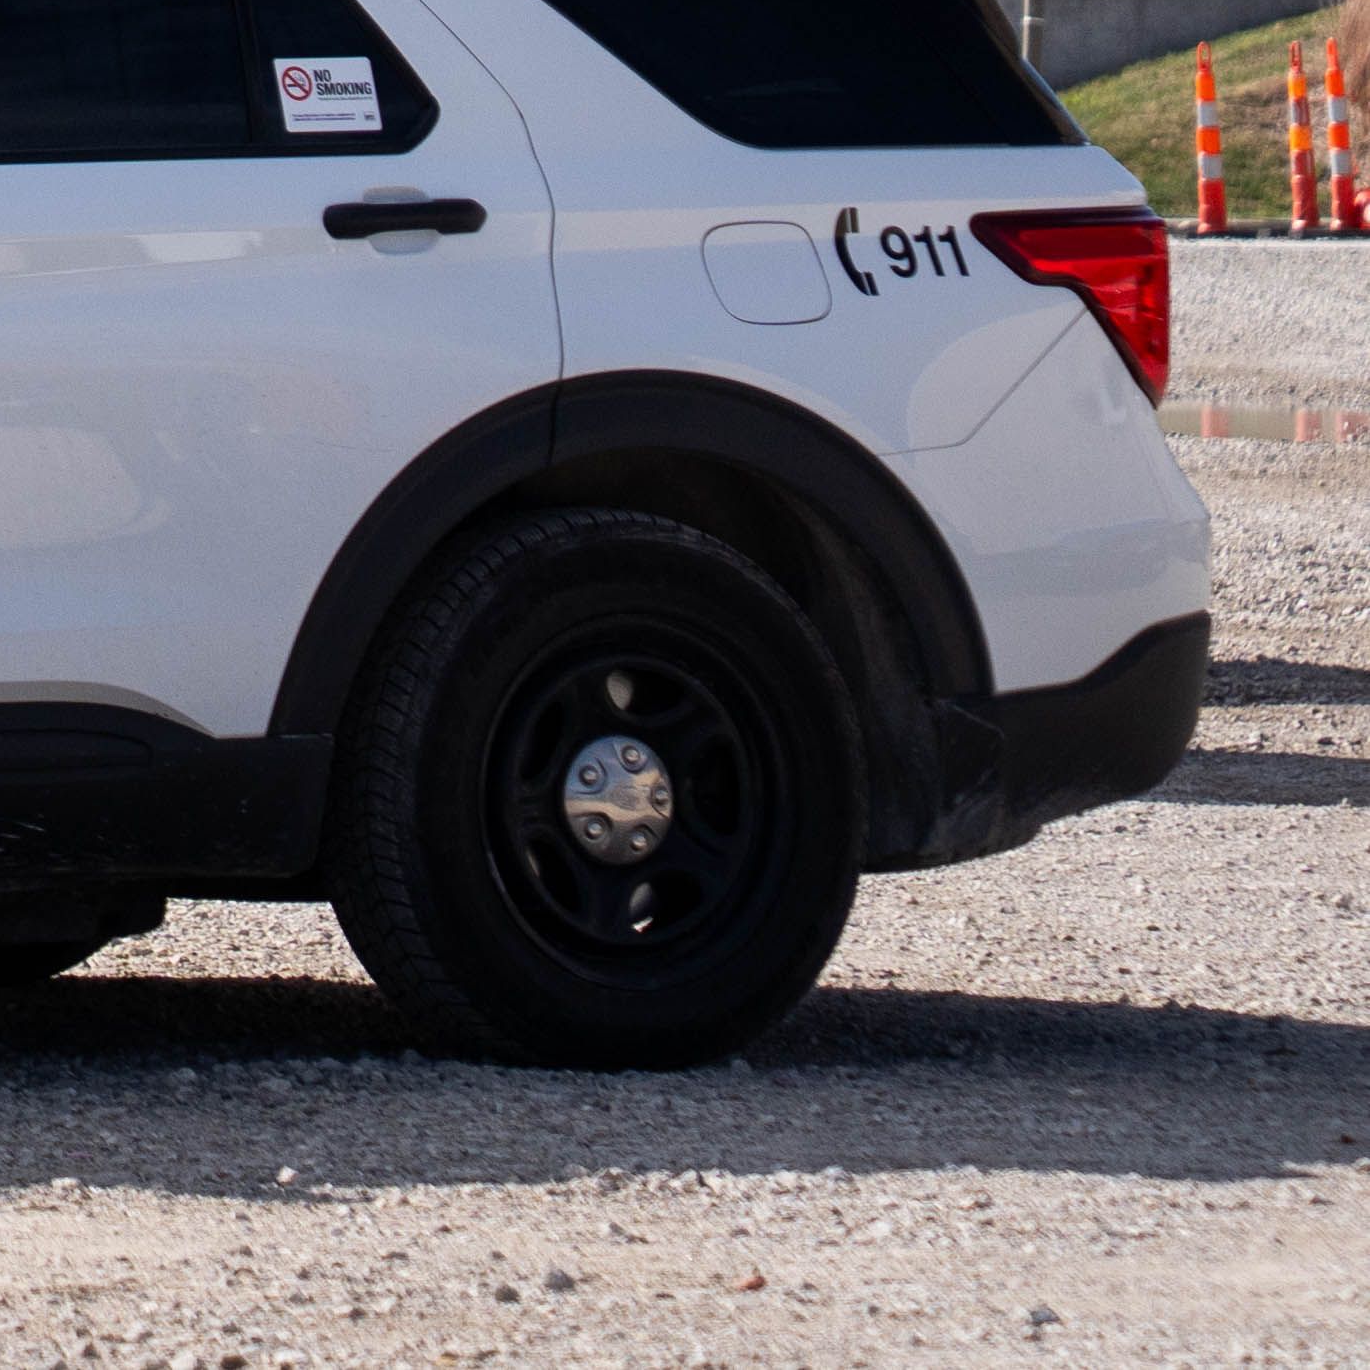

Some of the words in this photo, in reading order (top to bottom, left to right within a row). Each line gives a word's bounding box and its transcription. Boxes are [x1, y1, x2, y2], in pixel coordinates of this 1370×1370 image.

[313, 69, 332, 82] NO
[316, 81, 373, 96] SMOKING
[879, 225, 970, 277] 911
